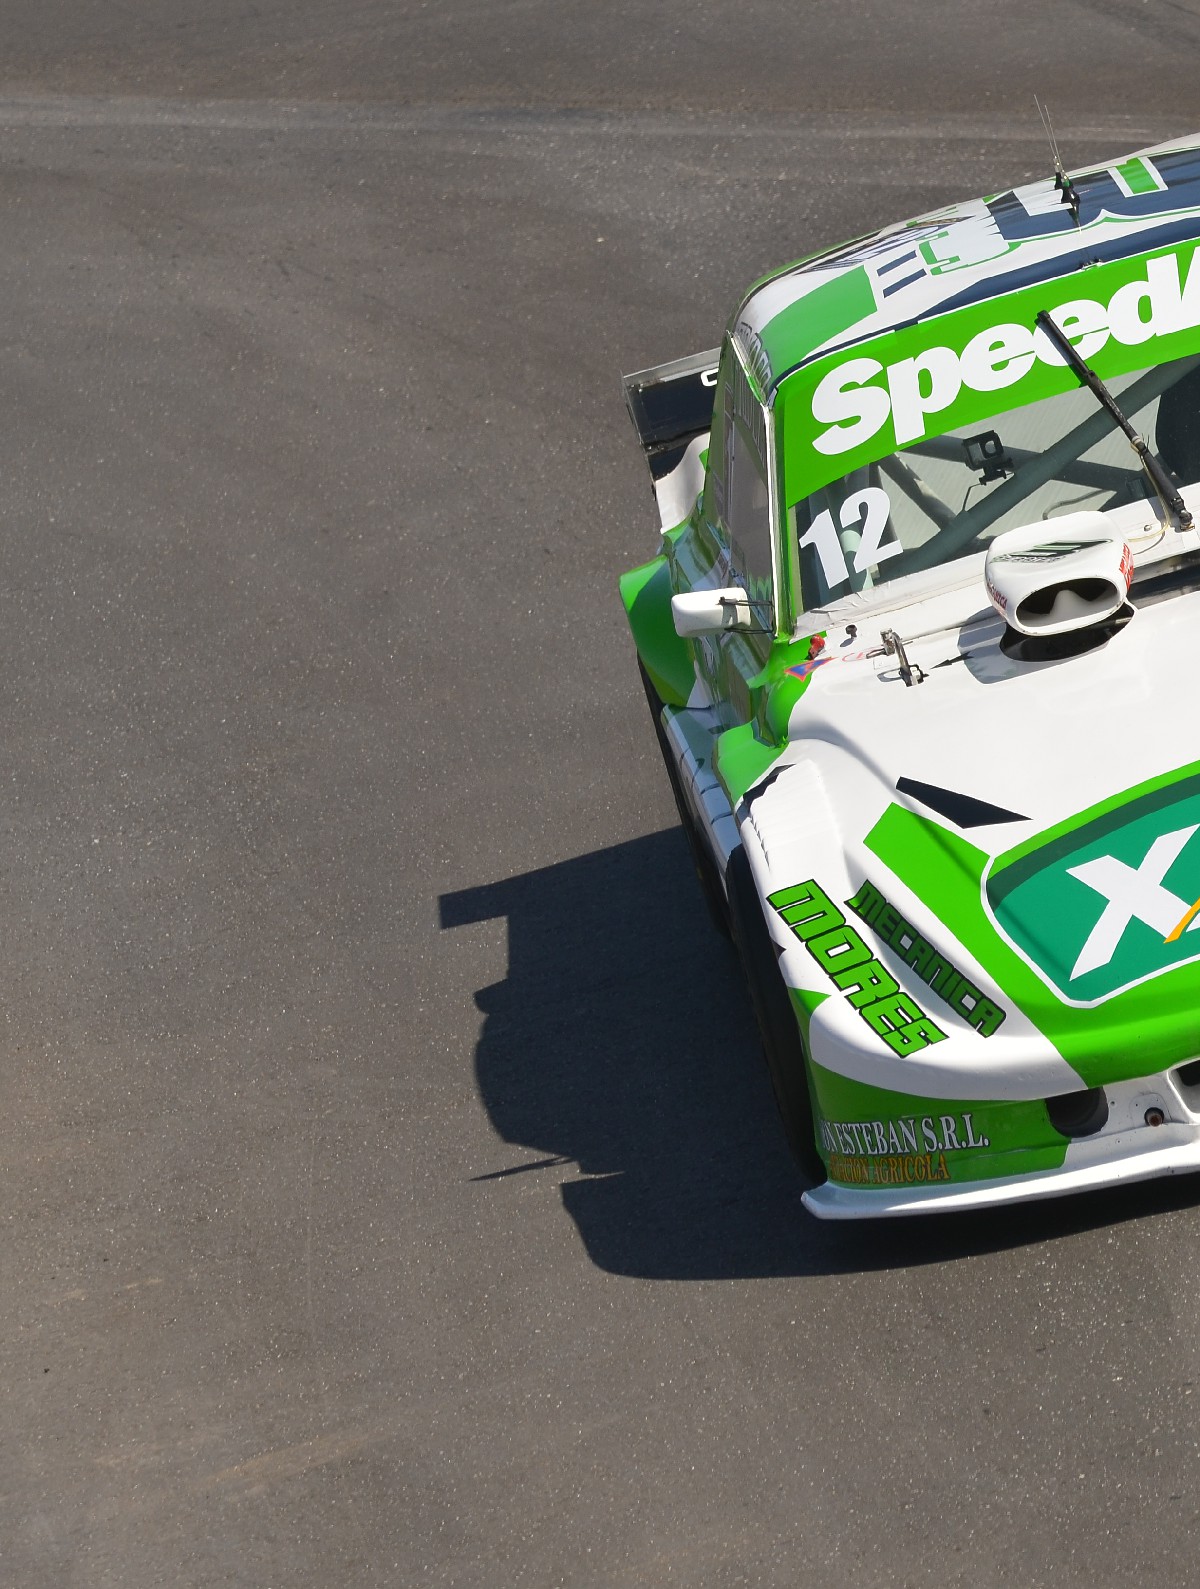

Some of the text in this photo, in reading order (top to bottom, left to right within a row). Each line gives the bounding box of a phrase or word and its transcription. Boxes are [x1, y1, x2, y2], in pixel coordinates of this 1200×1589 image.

[800, 486, 904, 589] 12
[766, 879, 950, 1059] MORES
[844, 879, 1007, 1038] MECANICA
[834, 1118, 918, 1156] ESTEBAN
[921, 1113, 990, 1153] S.R.L.
[873, 1152, 951, 1185] AGRICOLA
